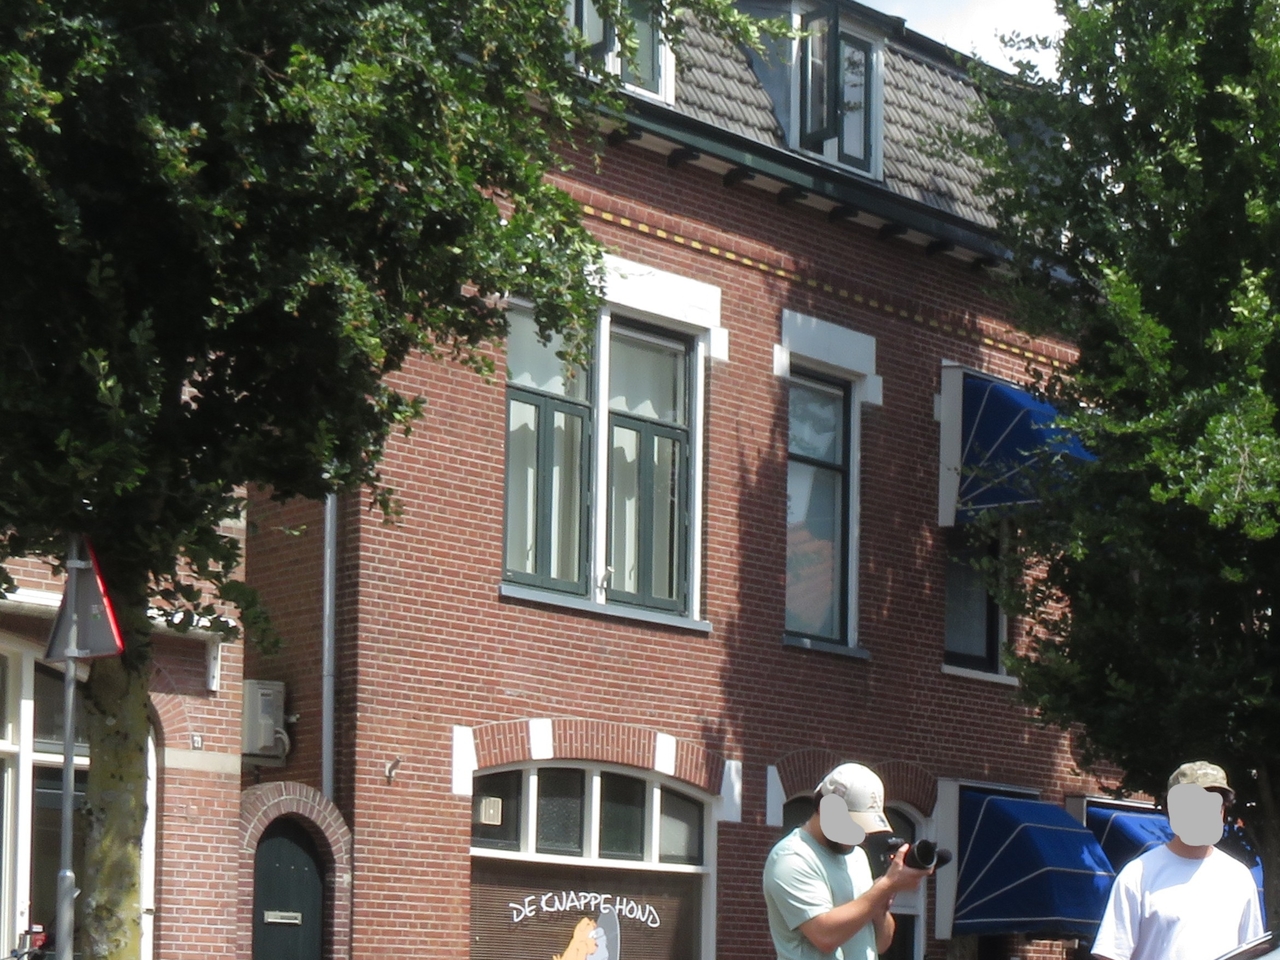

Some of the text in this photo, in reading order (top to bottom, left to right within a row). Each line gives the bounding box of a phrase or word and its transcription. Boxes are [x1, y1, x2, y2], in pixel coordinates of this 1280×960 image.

[508, 890, 661, 928] DE KNAPPE HOND
